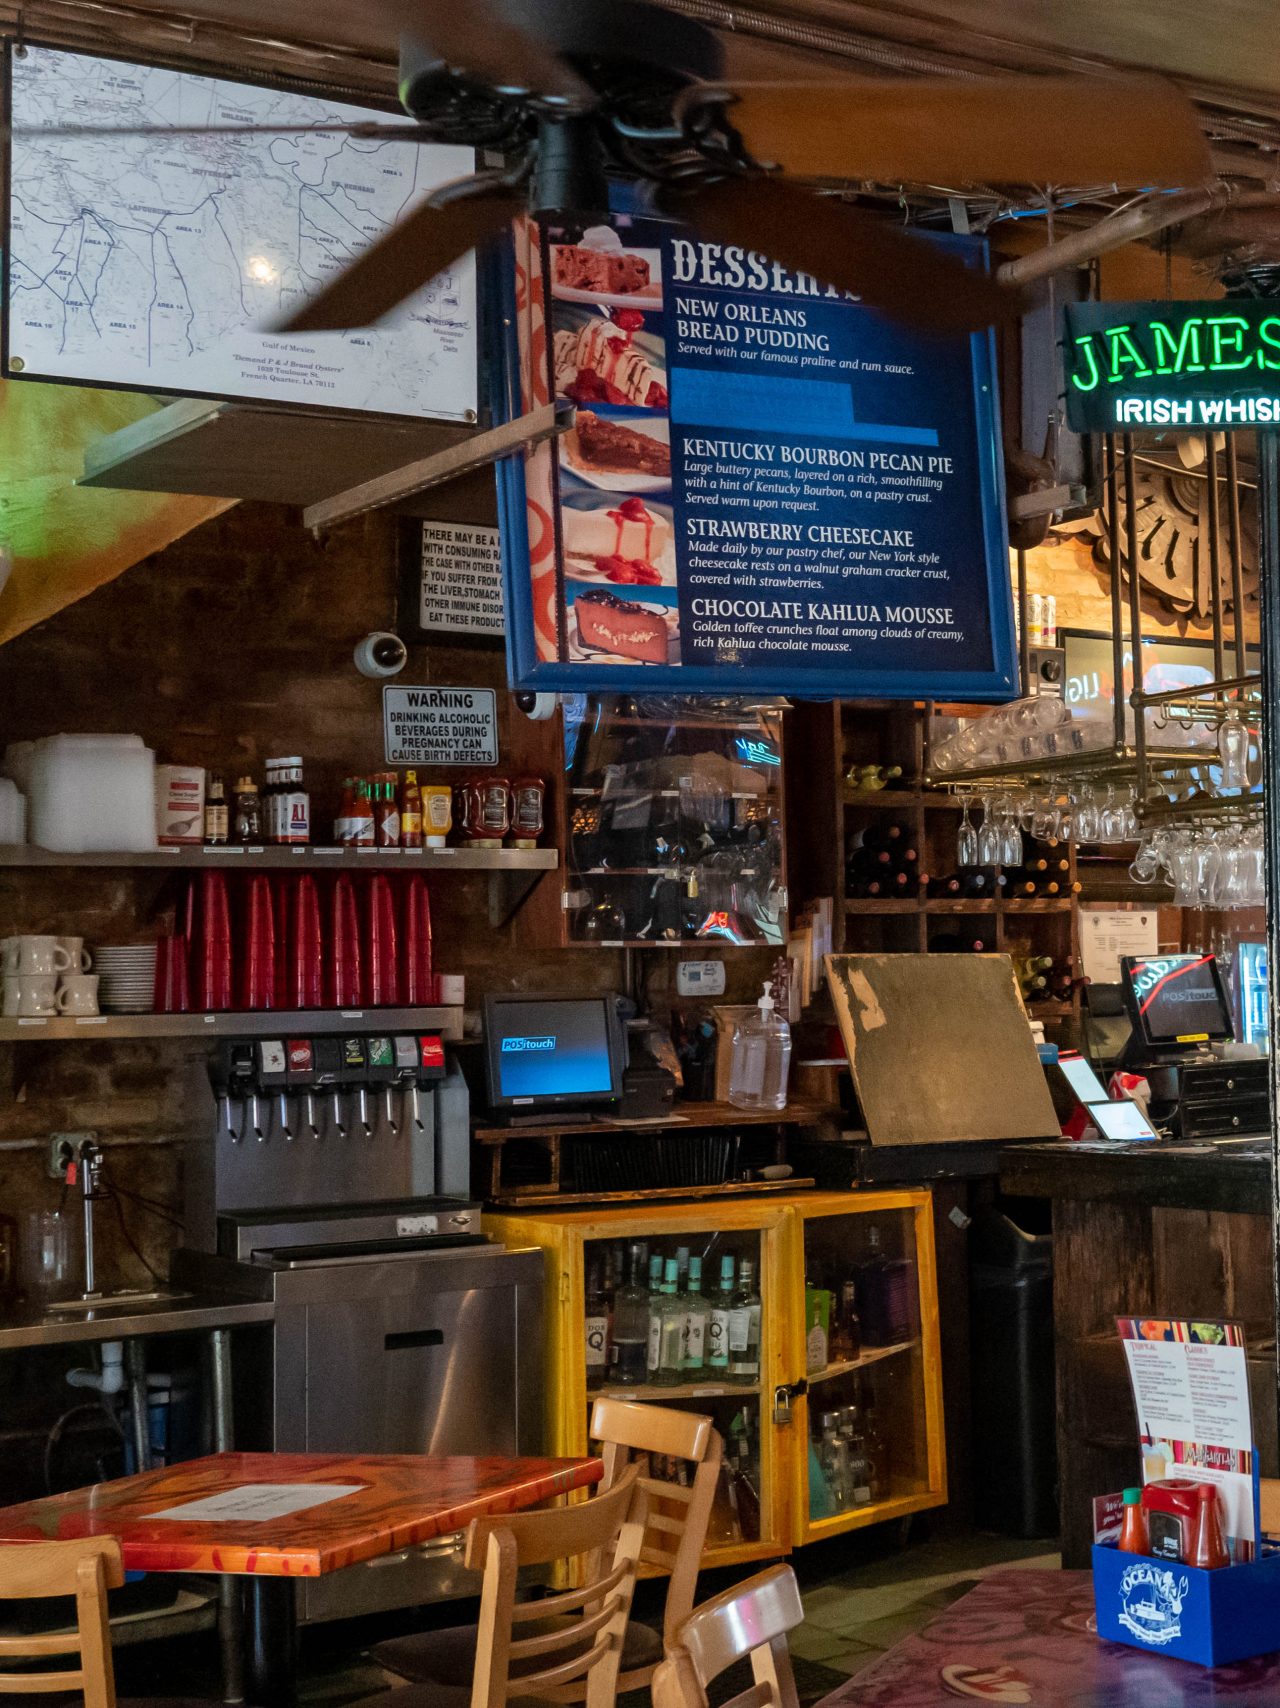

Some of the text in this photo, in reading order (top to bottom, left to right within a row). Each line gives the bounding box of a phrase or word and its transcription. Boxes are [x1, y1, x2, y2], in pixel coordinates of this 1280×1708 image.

[676, 297, 806, 327] NEW ORLEANS
[677, 320, 829, 351] BREAD PUDDING
[678, 342, 913, 374] Served with our famous praline and rum sauce.
[1116, 398, 1193, 424] IRISH
[684, 440, 952, 473] KENTUCKY BOURBON PECAN PIE
[684, 460, 712, 475] Large
[716, 462, 751, 478] buttery
[754, 468, 791, 479] pecans,
[794, 467, 830, 482] layered
[832, 473, 844, 481] on
[847, 474, 854, 482] a
[857, 473, 877, 485] rich,
[685, 477, 706, 487] with
[710, 480, 716, 488] a
[719, 478, 739, 490] hint
[742, 480, 755, 490] of
[756, 481, 800, 497] Kentucky
[803, 484, 846, 498] Bourbon,
[850, 490, 862, 498] on
[874, 491, 903, 503] pastry
[906, 493, 931, 502] crust.
[685, 492, 819, 512] Served warm upon request.
[422, 528, 496, 546] THERE MAY BE A
[687, 519, 914, 546] STRAWBERRY CHEESECAKE
[422, 542, 443, 554] WITH
[445, 545, 491, 559] CONSUMING
[688, 540, 939, 565] Made daily by our pastry chef, our New York style
[422, 555, 434, 568] THE
[436, 558, 452, 568] CASE
[454, 560, 470, 570] WITH
[472, 562, 493, 572] OTHER
[689, 556, 949, 580] cheesecake rests on a walnut graham cracker crust,
[422, 571, 430, 582] IF
[431, 571, 445, 581] YOU
[448, 573, 475, 584] SUFFER
[477, 576, 497, 586] FROM
[690, 574, 824, 588] covered with strawberries.
[423, 583, 438, 594] THE
[424, 597, 449, 608] OTHER
[451, 600, 480, 612] IMMUNE
[692, 600, 953, 624] CHOCOLATE KAHLUA MOUSSE
[429, 612, 443, 622] EAT
[445, 613, 468, 624] THESE
[693, 620, 963, 642] Golden toffee crunches float among clouds of creamy,
[694, 636, 851, 651] rich Kahlua chocolate mousse.
[407, 692, 473, 709] WARNING
[390, 712, 490, 724] DRINKING ALCOHOLIC
[395, 724, 486, 737] BEVERAGES DURING
[402, 737, 481, 748] PREGNANCY CAN
[392, 750, 493, 762] CAUSE BIRTH DEFECTS
